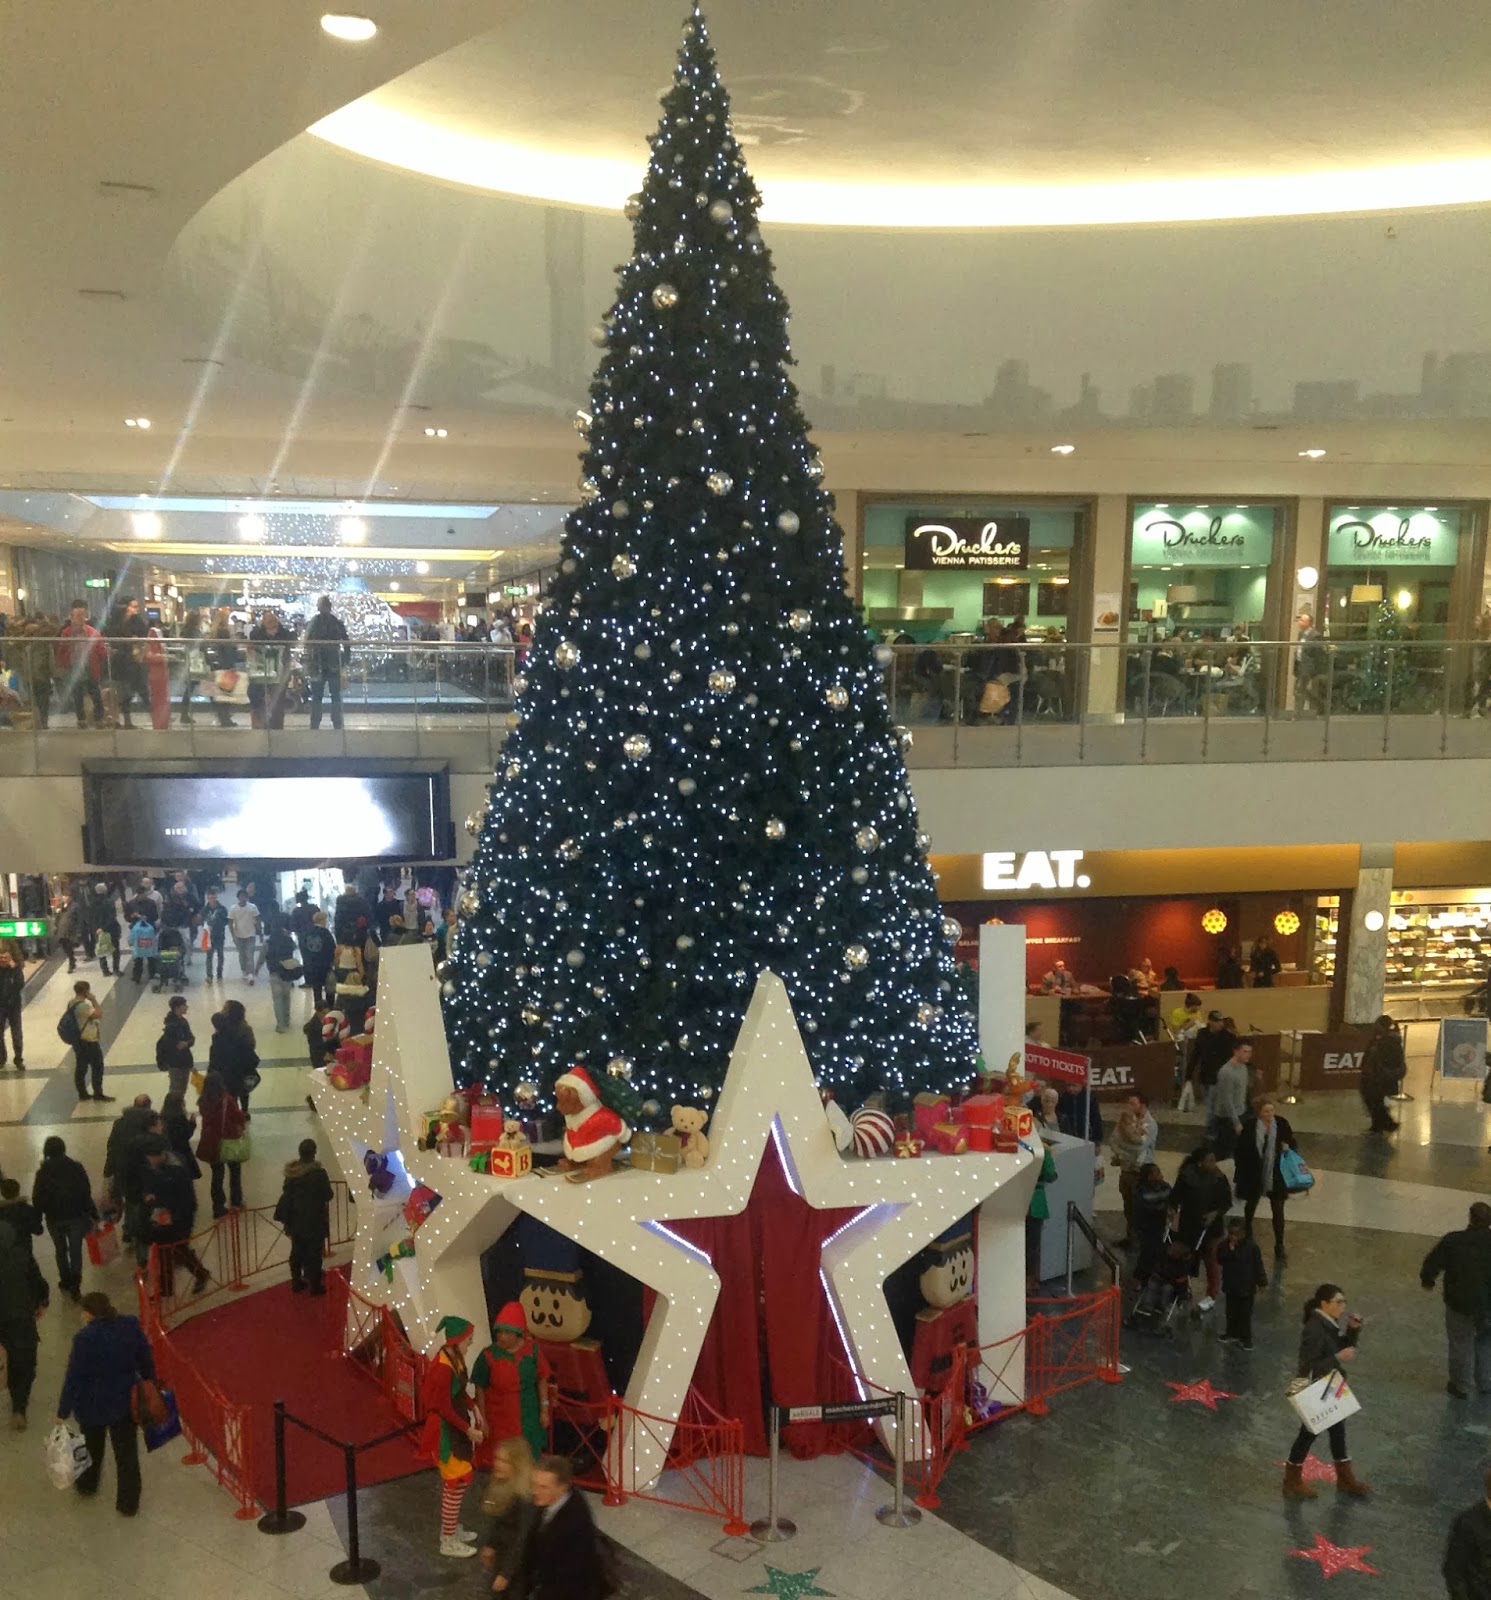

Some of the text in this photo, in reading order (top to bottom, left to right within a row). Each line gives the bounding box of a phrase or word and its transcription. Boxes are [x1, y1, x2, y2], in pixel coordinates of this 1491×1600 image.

[914, 522, 1021, 556] Druckers
[1145, 517, 1245, 548] Druckers
[1336, 518, 1432, 548] Druckers
[932, 556, 1020, 565] VIENNA PATISSERIE
[983, 850, 1091, 890] EAT.
[1051, 1059, 1085, 1077] TICKETS
[1090, 1066, 1135, 1086] EAT.
[520, 1154, 529, 1171] B
